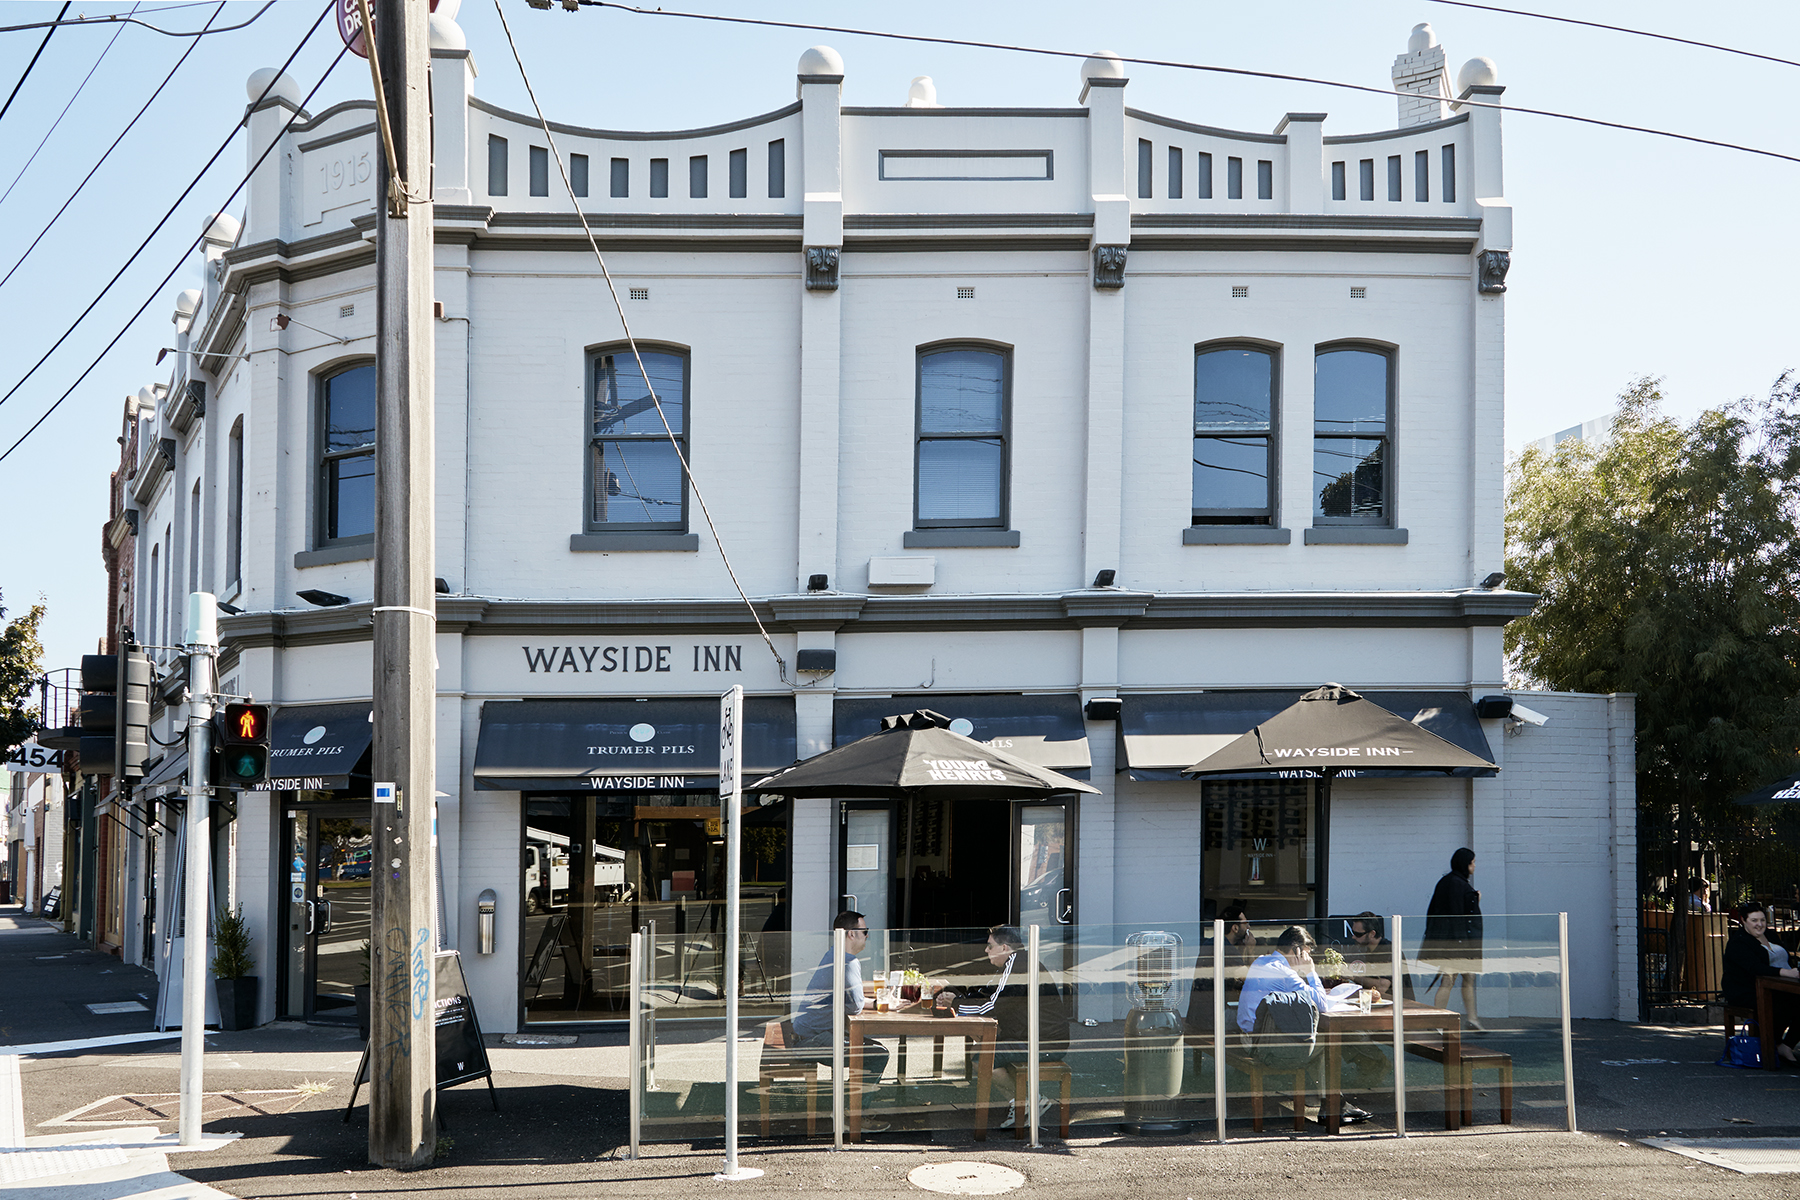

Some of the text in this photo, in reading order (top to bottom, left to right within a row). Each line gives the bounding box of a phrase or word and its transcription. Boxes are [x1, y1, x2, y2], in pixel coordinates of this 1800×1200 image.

[320, 151, 371, 194] 1915
[522, 645, 742, 673] WAYSIDE INN
[270, 745, 344, 758] RUMER PILS
[587, 745, 695, 755] TRUMER PILS
[1274, 747, 1400, 758] WAYSIDE INN
[9, 747, 64, 768] 454
[720, 758, 733, 784] LANE
[926, 769, 1007, 781] HENRYS
[255, 777, 323, 791] WAYSIDE INN
[591, 776, 685, 789] WAYSIDE INN
[456, 1061, 465, 1071] W
